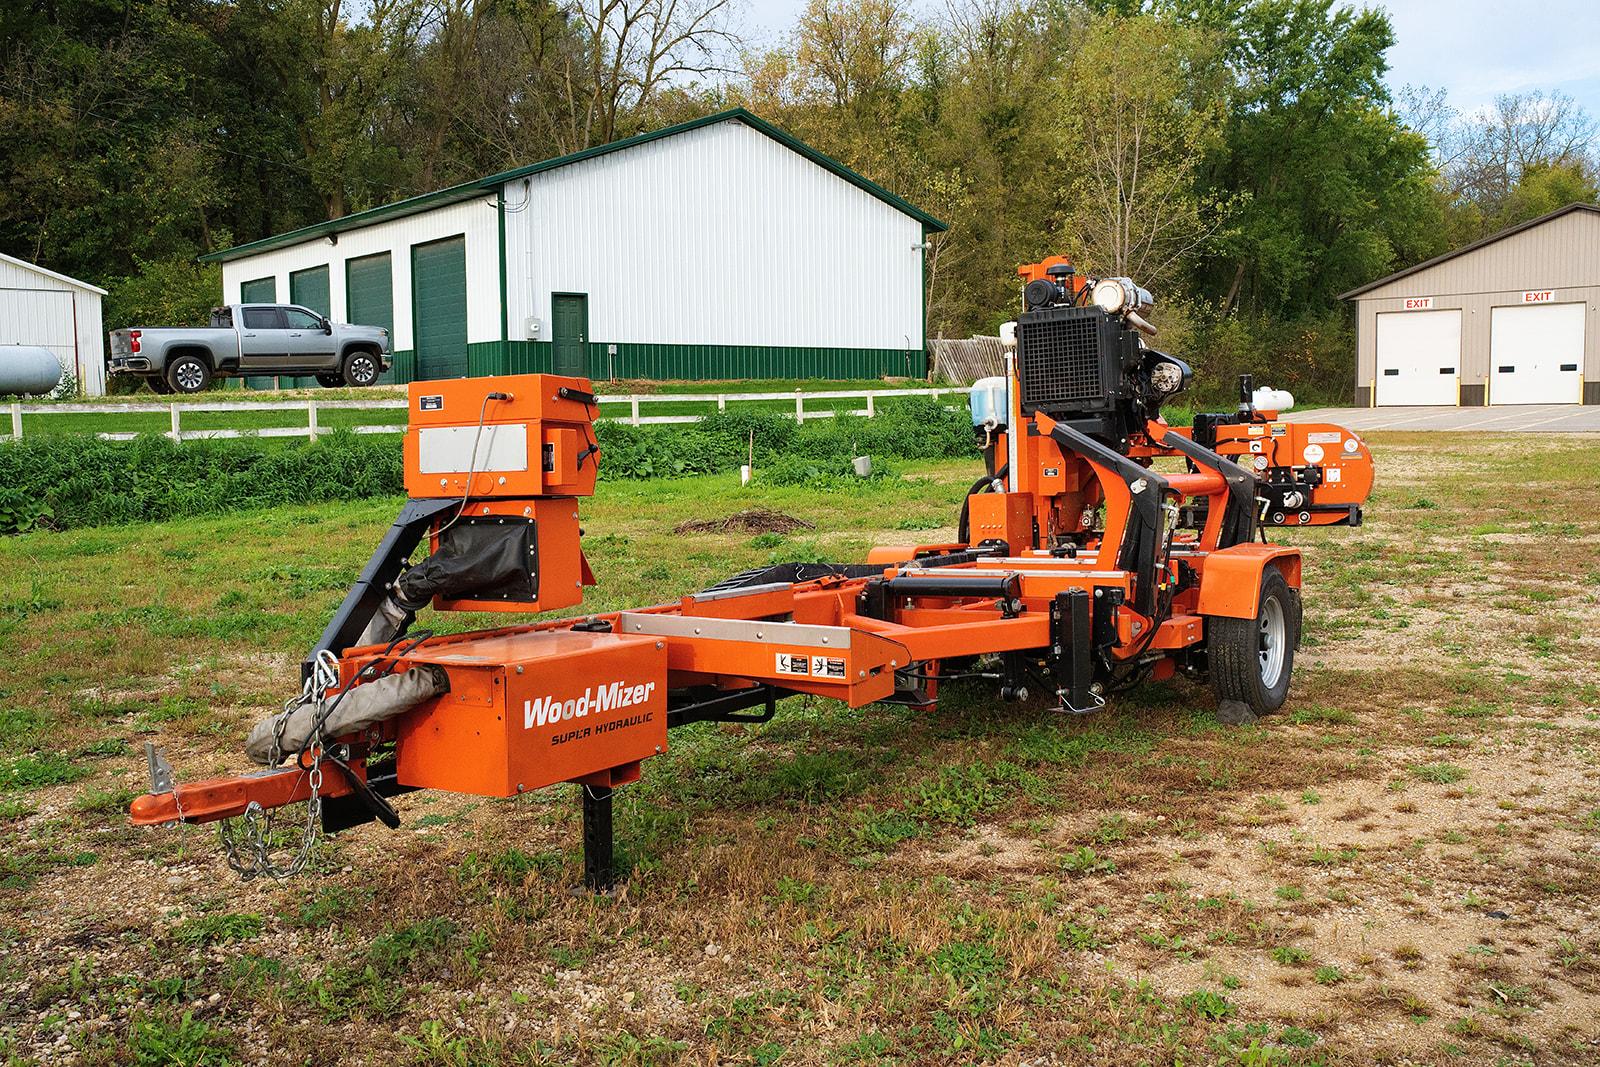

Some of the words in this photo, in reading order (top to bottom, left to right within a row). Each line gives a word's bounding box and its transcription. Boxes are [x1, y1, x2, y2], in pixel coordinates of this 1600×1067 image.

[1406, 299, 1430, 308] EXIT
[1525, 291, 1552, 302] EXIT
[524, 681, 655, 729] Wood-Mizer
[551, 727, 591, 746] SUPER
[595, 712, 653, 735] HYDRAULIC
